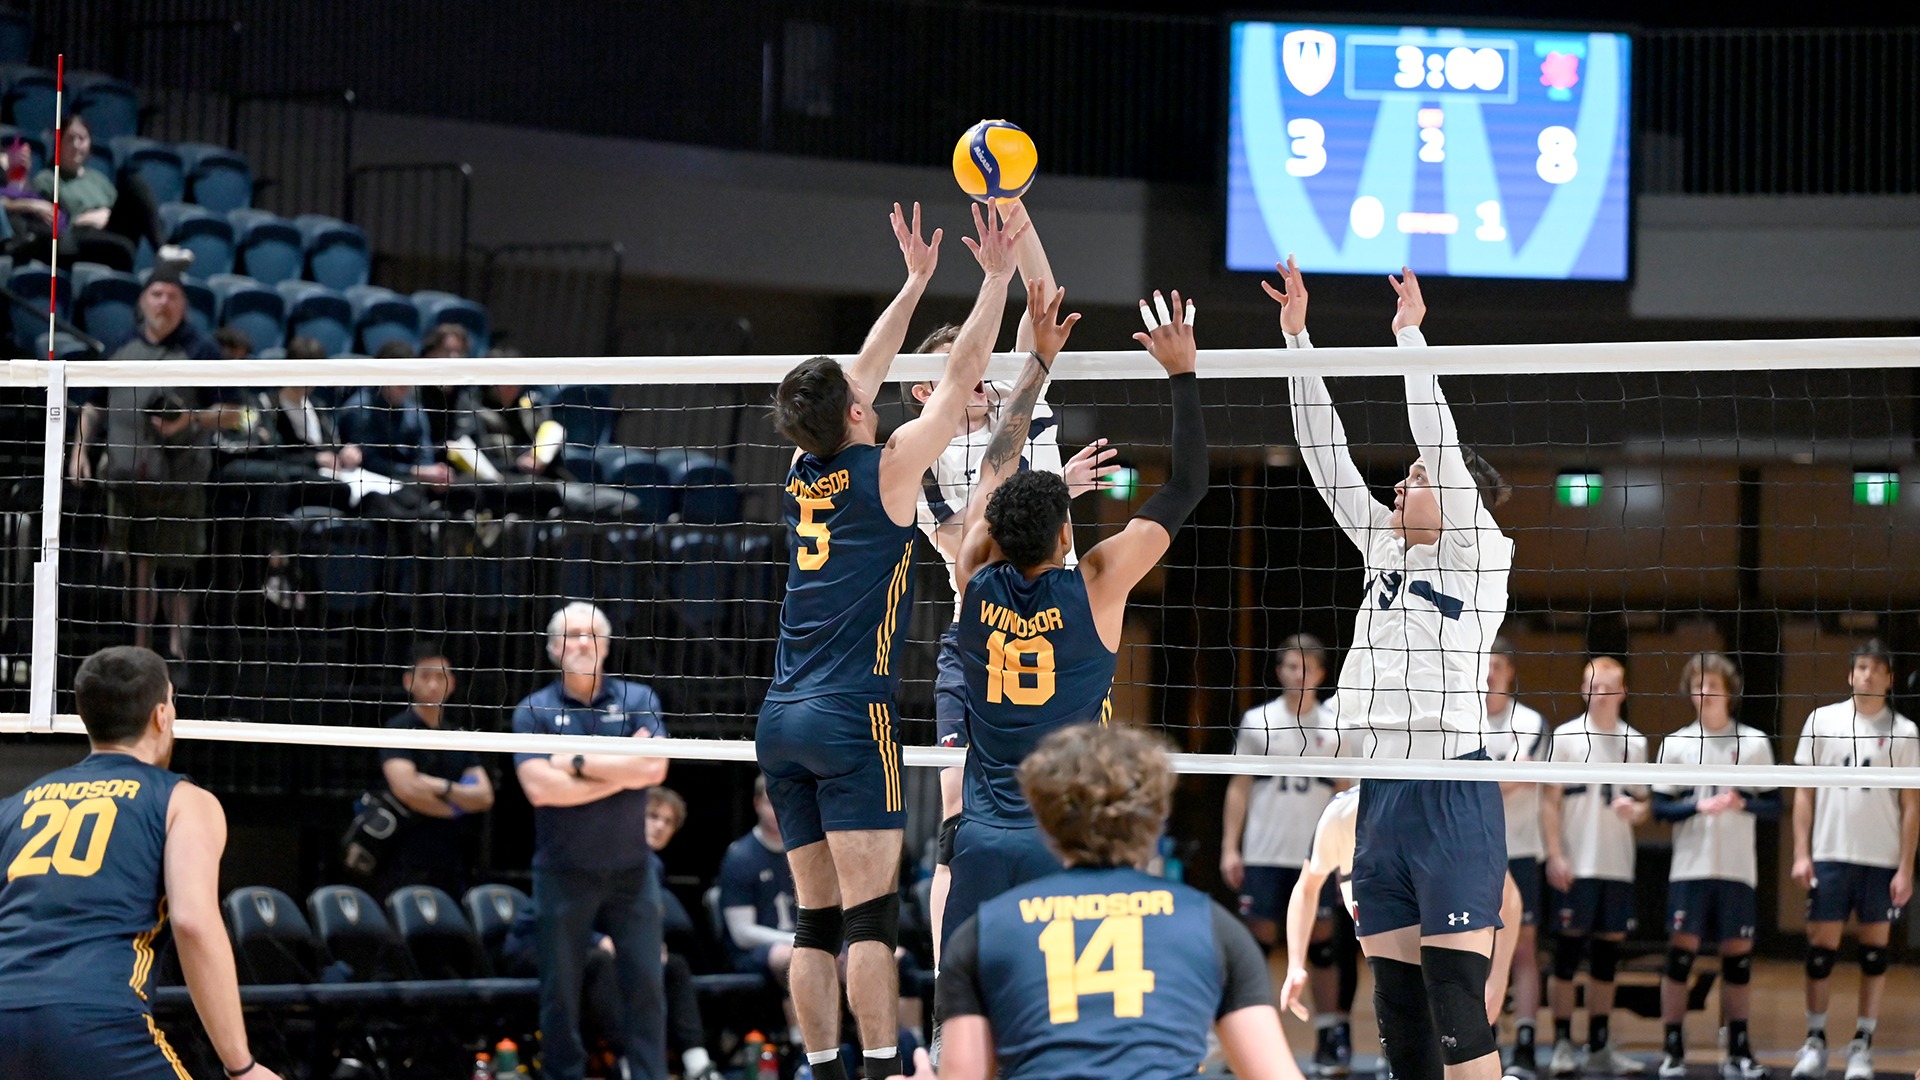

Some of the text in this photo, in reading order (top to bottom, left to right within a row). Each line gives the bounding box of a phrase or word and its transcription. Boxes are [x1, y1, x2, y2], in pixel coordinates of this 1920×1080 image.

[1394, 45, 1505, 91] 3:00
[1285, 118, 1327, 178] 3
[1418, 127, 1445, 163] 2
[1536, 125, 1578, 184] 8
[1350, 196, 1385, 239] 0
[1475, 200, 1506, 242] 1
[795, 496, 836, 571] 5
[980, 599, 1064, 639] WINDSOR
[985, 629, 1056, 706] 18
[23, 778, 141, 806] WINDSOR
[7, 796, 118, 883] 20
[1019, 889, 1174, 924] WINDSOR
[1038, 915, 1155, 1025] 14
